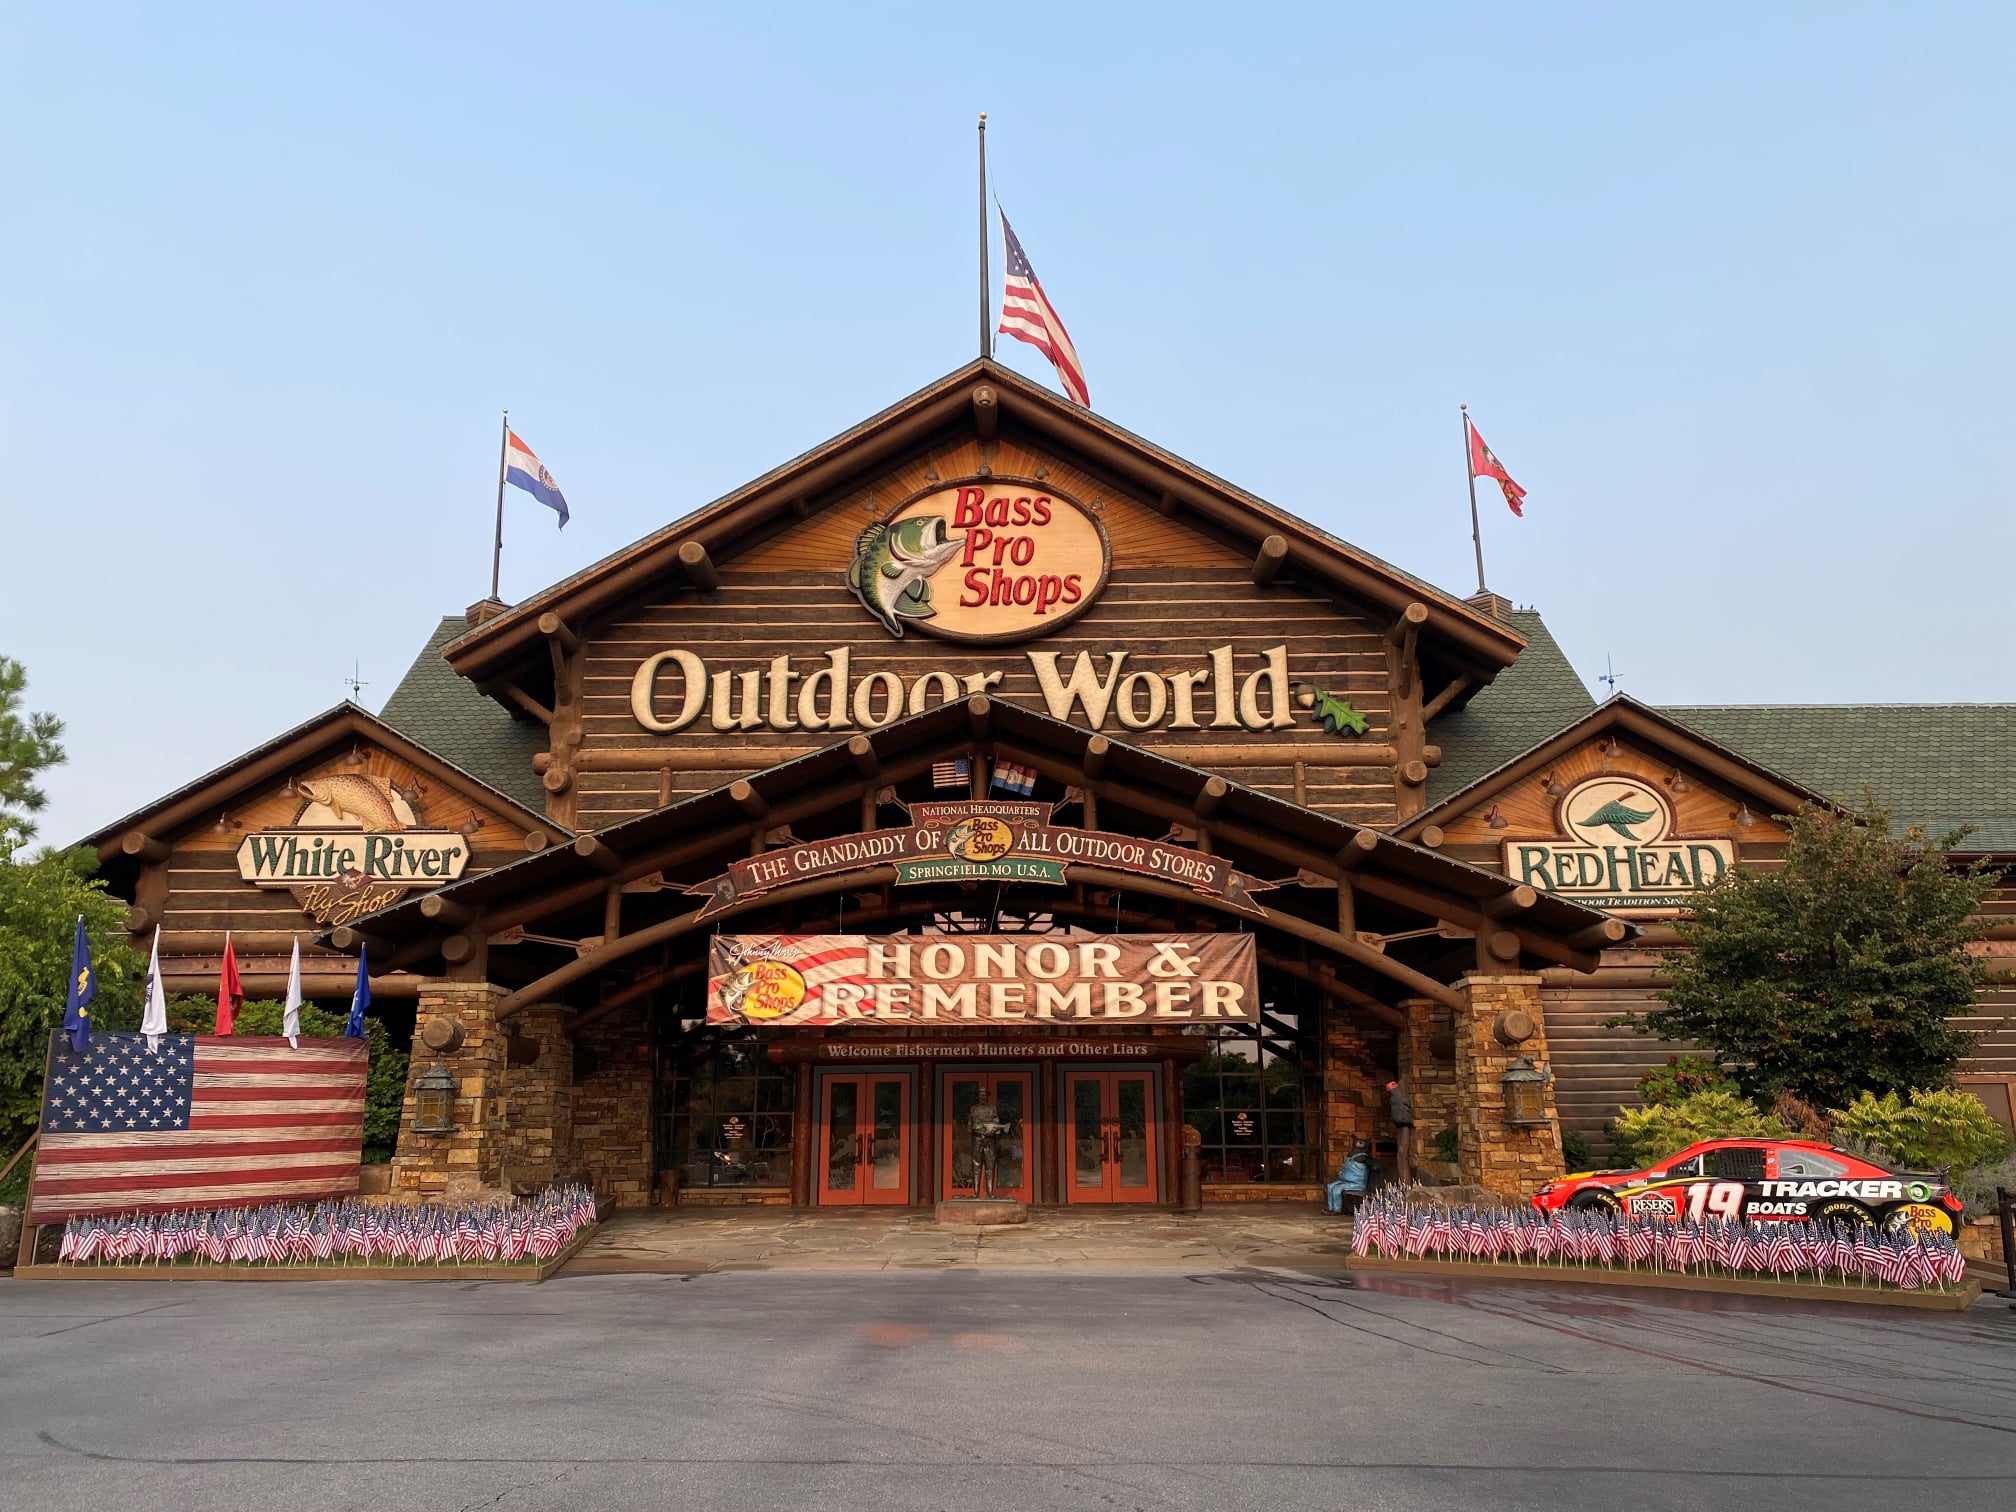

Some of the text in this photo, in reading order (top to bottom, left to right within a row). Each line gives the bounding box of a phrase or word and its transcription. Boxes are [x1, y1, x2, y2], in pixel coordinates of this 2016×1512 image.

[951, 487, 1051, 529] Bass
[960, 528, 1035, 567] Pro
[960, 567, 1082, 615] Shops
[1025, 643, 1297, 733] World
[922, 804, 1040, 817] NATIONAL HEADQUARTERS
[972, 818, 999, 831] Bass
[973, 830, 993, 842] Pro
[249, 835, 462, 880] White River
[747, 829, 1216, 884] THE GRANDADDY OF ALL OUTDOOR STORES
[973, 842, 1006, 857] Shops
[991, 864, 1012, 876] MO
[1017, 864, 1051, 878] U.S.A.
[1517, 844, 1725, 892] REDHEAD
[303, 884, 403, 926] Fly Shop
[1607, 897, 1661, 906] TRADITION
[865, 942, 1200, 980] HONOR &
[754, 963, 788, 980] Bass
[754, 980, 780, 994] Pro
[753, 994, 796, 1014] Shops
[820, 981, 1249, 1020] REMEMBER
[827, 1044, 891, 1058] Welcome
[979, 1043, 1034, 1056] Hunters
[1037, 1043, 1065, 1056] and
[1068, 1042, 1108, 1055] Other
[1112, 1042, 1148, 1056] Liars
[1758, 1180, 1902, 1199] TRACKER
[1687, 1182, 1745, 1226] 19
[1746, 1202, 1808, 1215] BOATS
[1910, 1205, 1936, 1217] Bass
[1911, 1217, 1932, 1228] Pro
